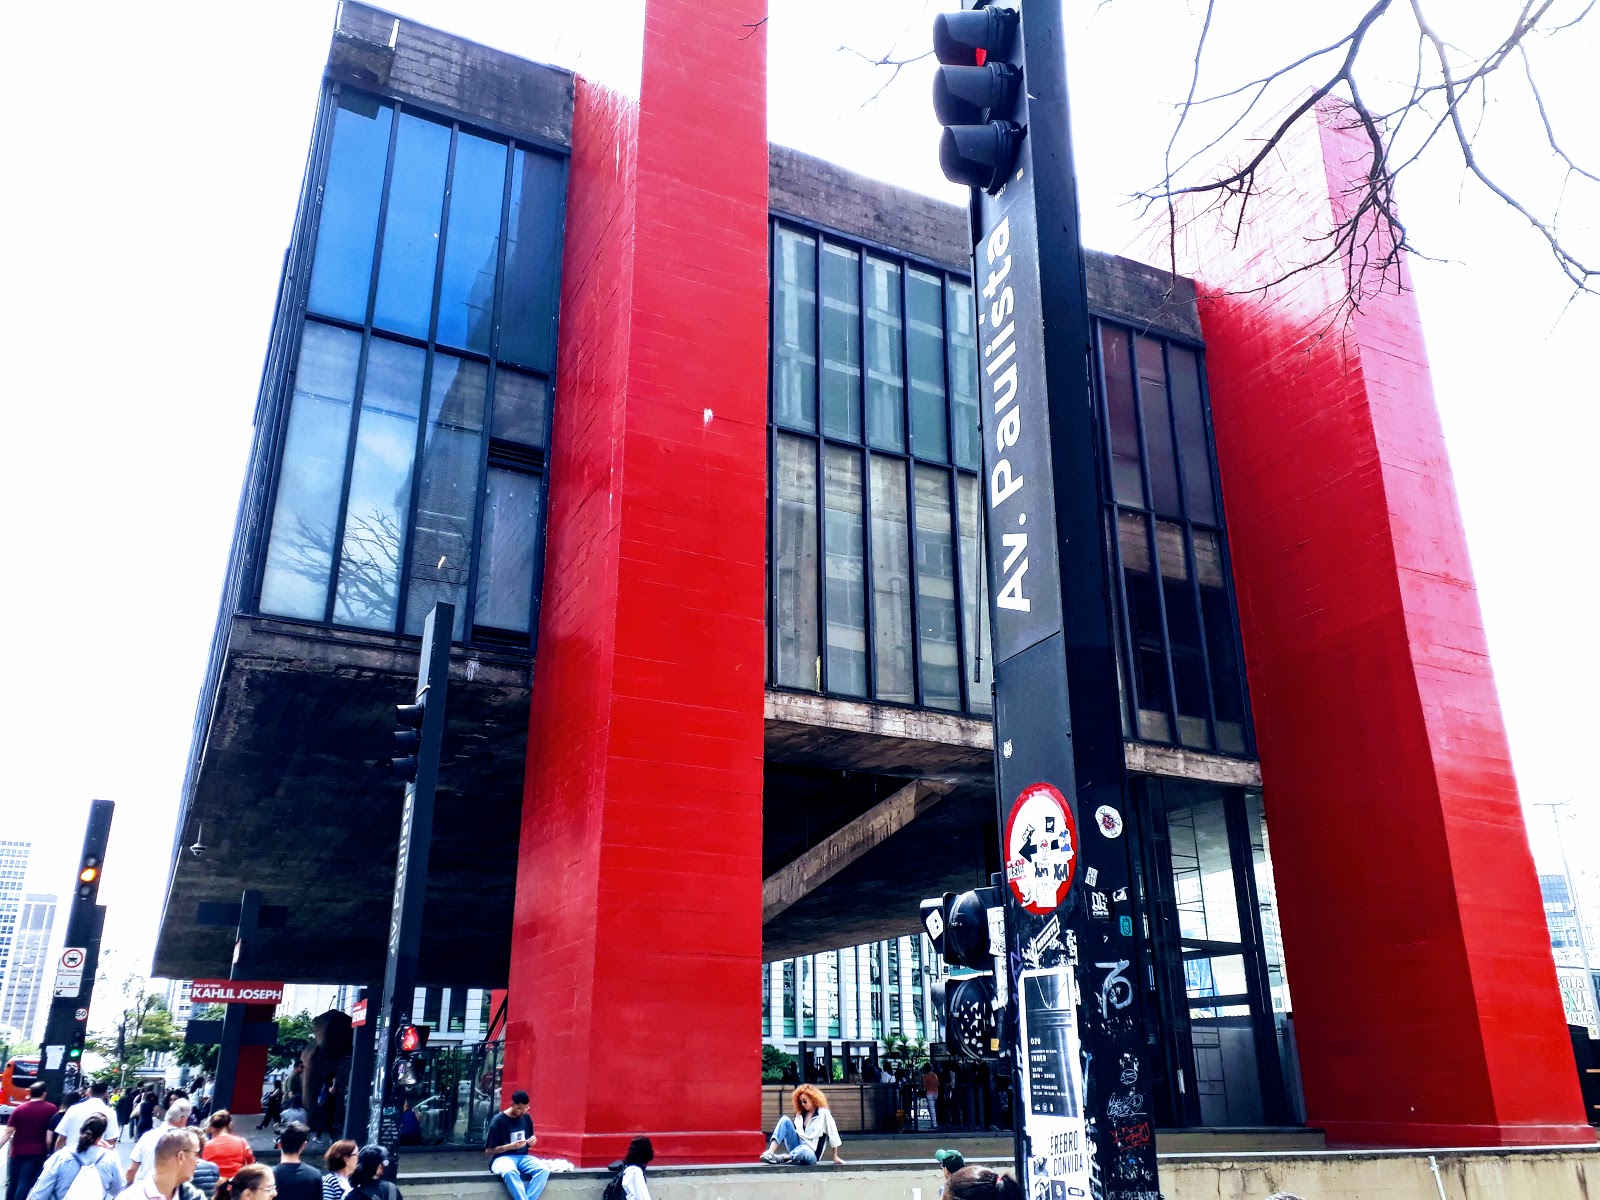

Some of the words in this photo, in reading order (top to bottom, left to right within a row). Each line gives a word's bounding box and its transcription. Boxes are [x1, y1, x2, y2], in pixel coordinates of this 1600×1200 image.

[982, 215, 1025, 510] Paulista
[996, 512, 1032, 614] Av.
[192, 988, 235, 999] KAHLIL
[237, 989, 282, 1000] JOSEPH
[1053, 1152, 1083, 1177] CONVIDA
